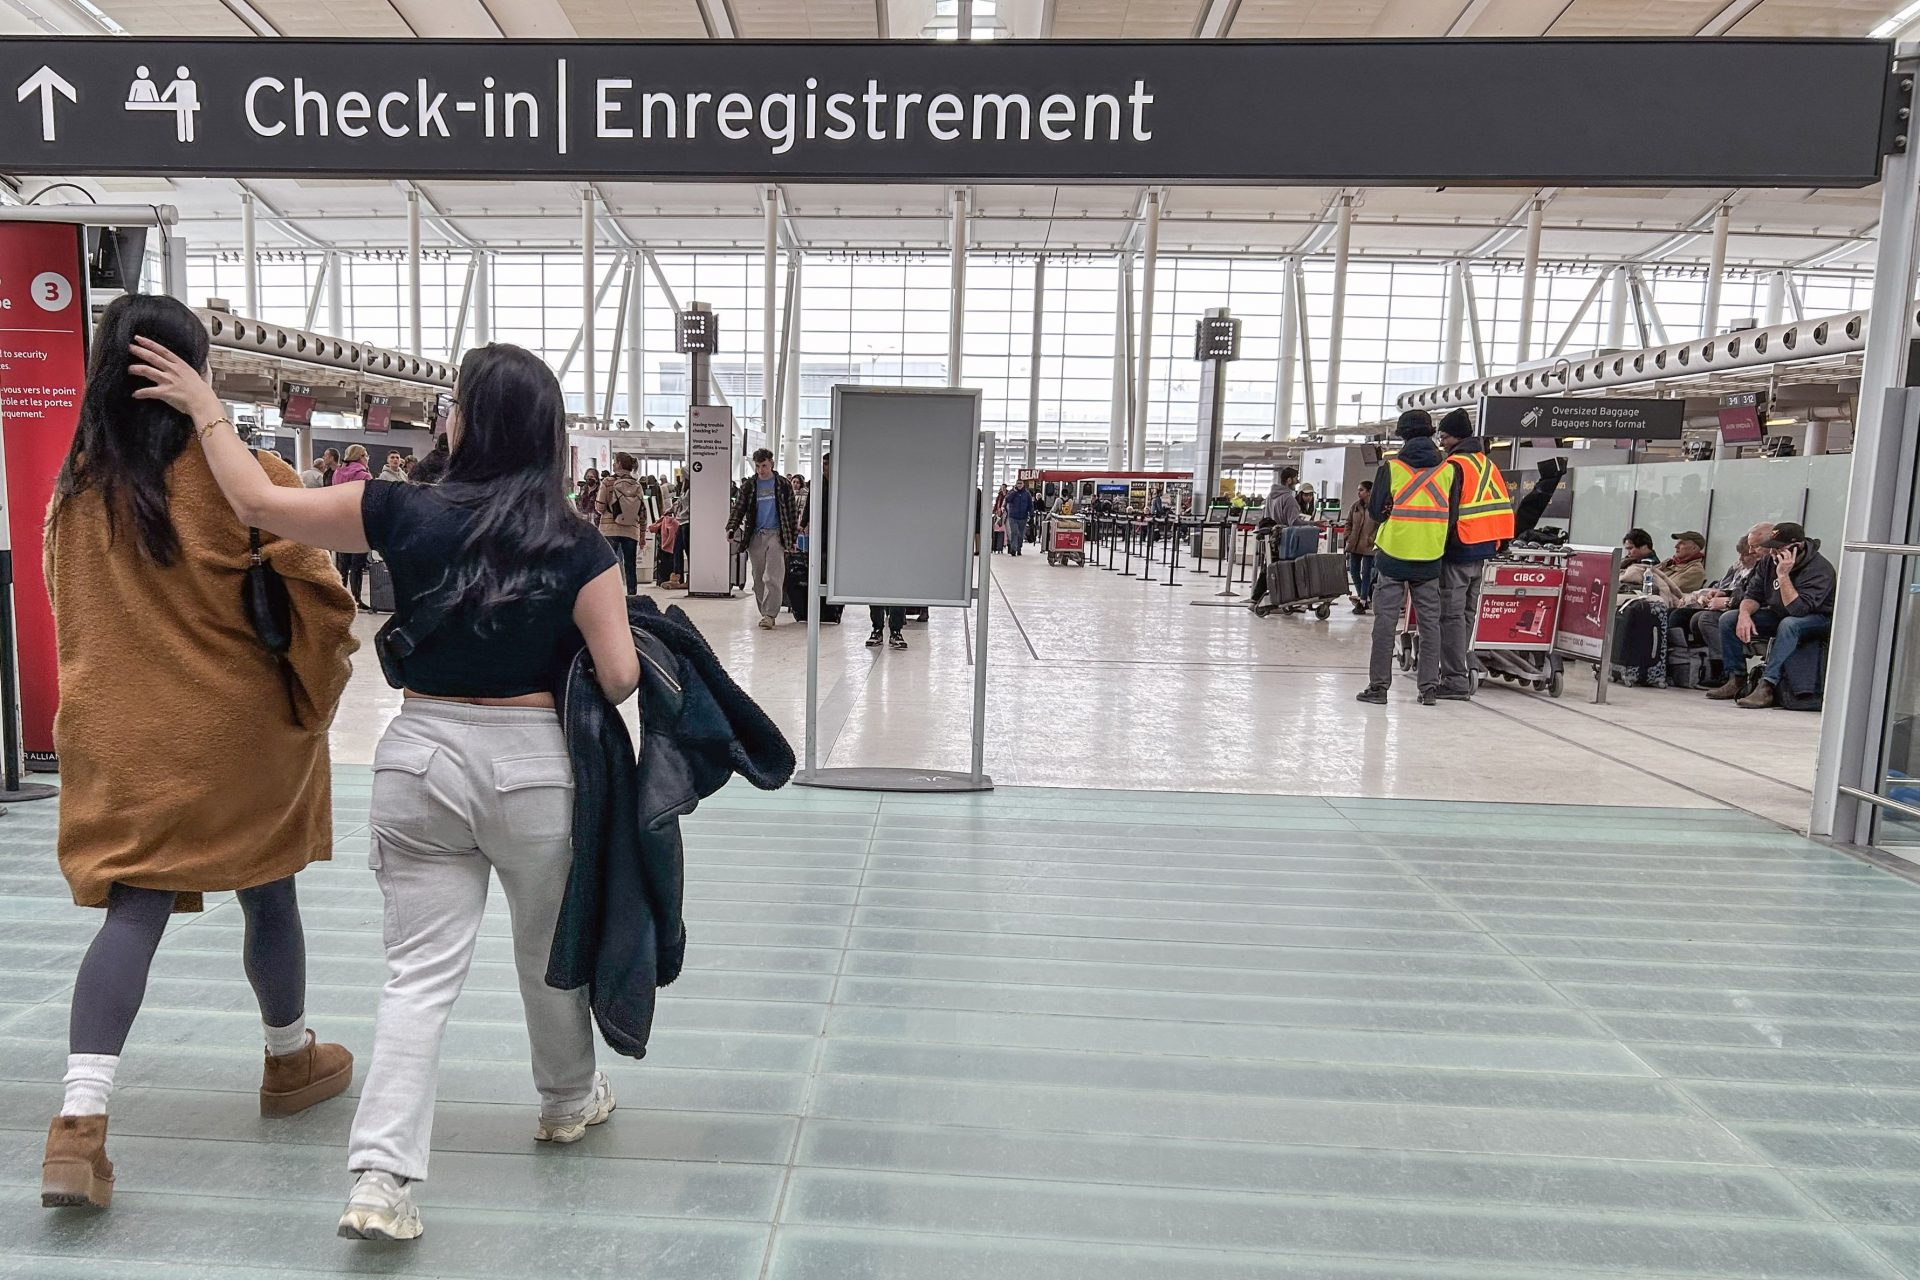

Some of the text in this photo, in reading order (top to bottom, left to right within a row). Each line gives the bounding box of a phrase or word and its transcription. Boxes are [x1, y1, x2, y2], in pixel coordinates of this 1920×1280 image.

[245, 76, 1154, 155] Check-in Enregistrement
[45, 282, 59, 301] 3
[683, 315, 705, 348] 2
[1209, 322, 1233, 355] 3
[3, 350, 12, 358] to
[13, 350, 48, 361] security
[42, 386, 51, 395] le
[52, 387, 77, 397] point
[19, 398, 29, 406] et
[30, 398, 43, 406] les
[44, 399, 73, 409] portes
[1552, 406, 1640, 418] Oversized Baggage
[1551, 418, 1646, 429] Bagages hors format
[1020, 470, 1040, 480] RELAY
[1513, 573, 1536, 582] CIBC
